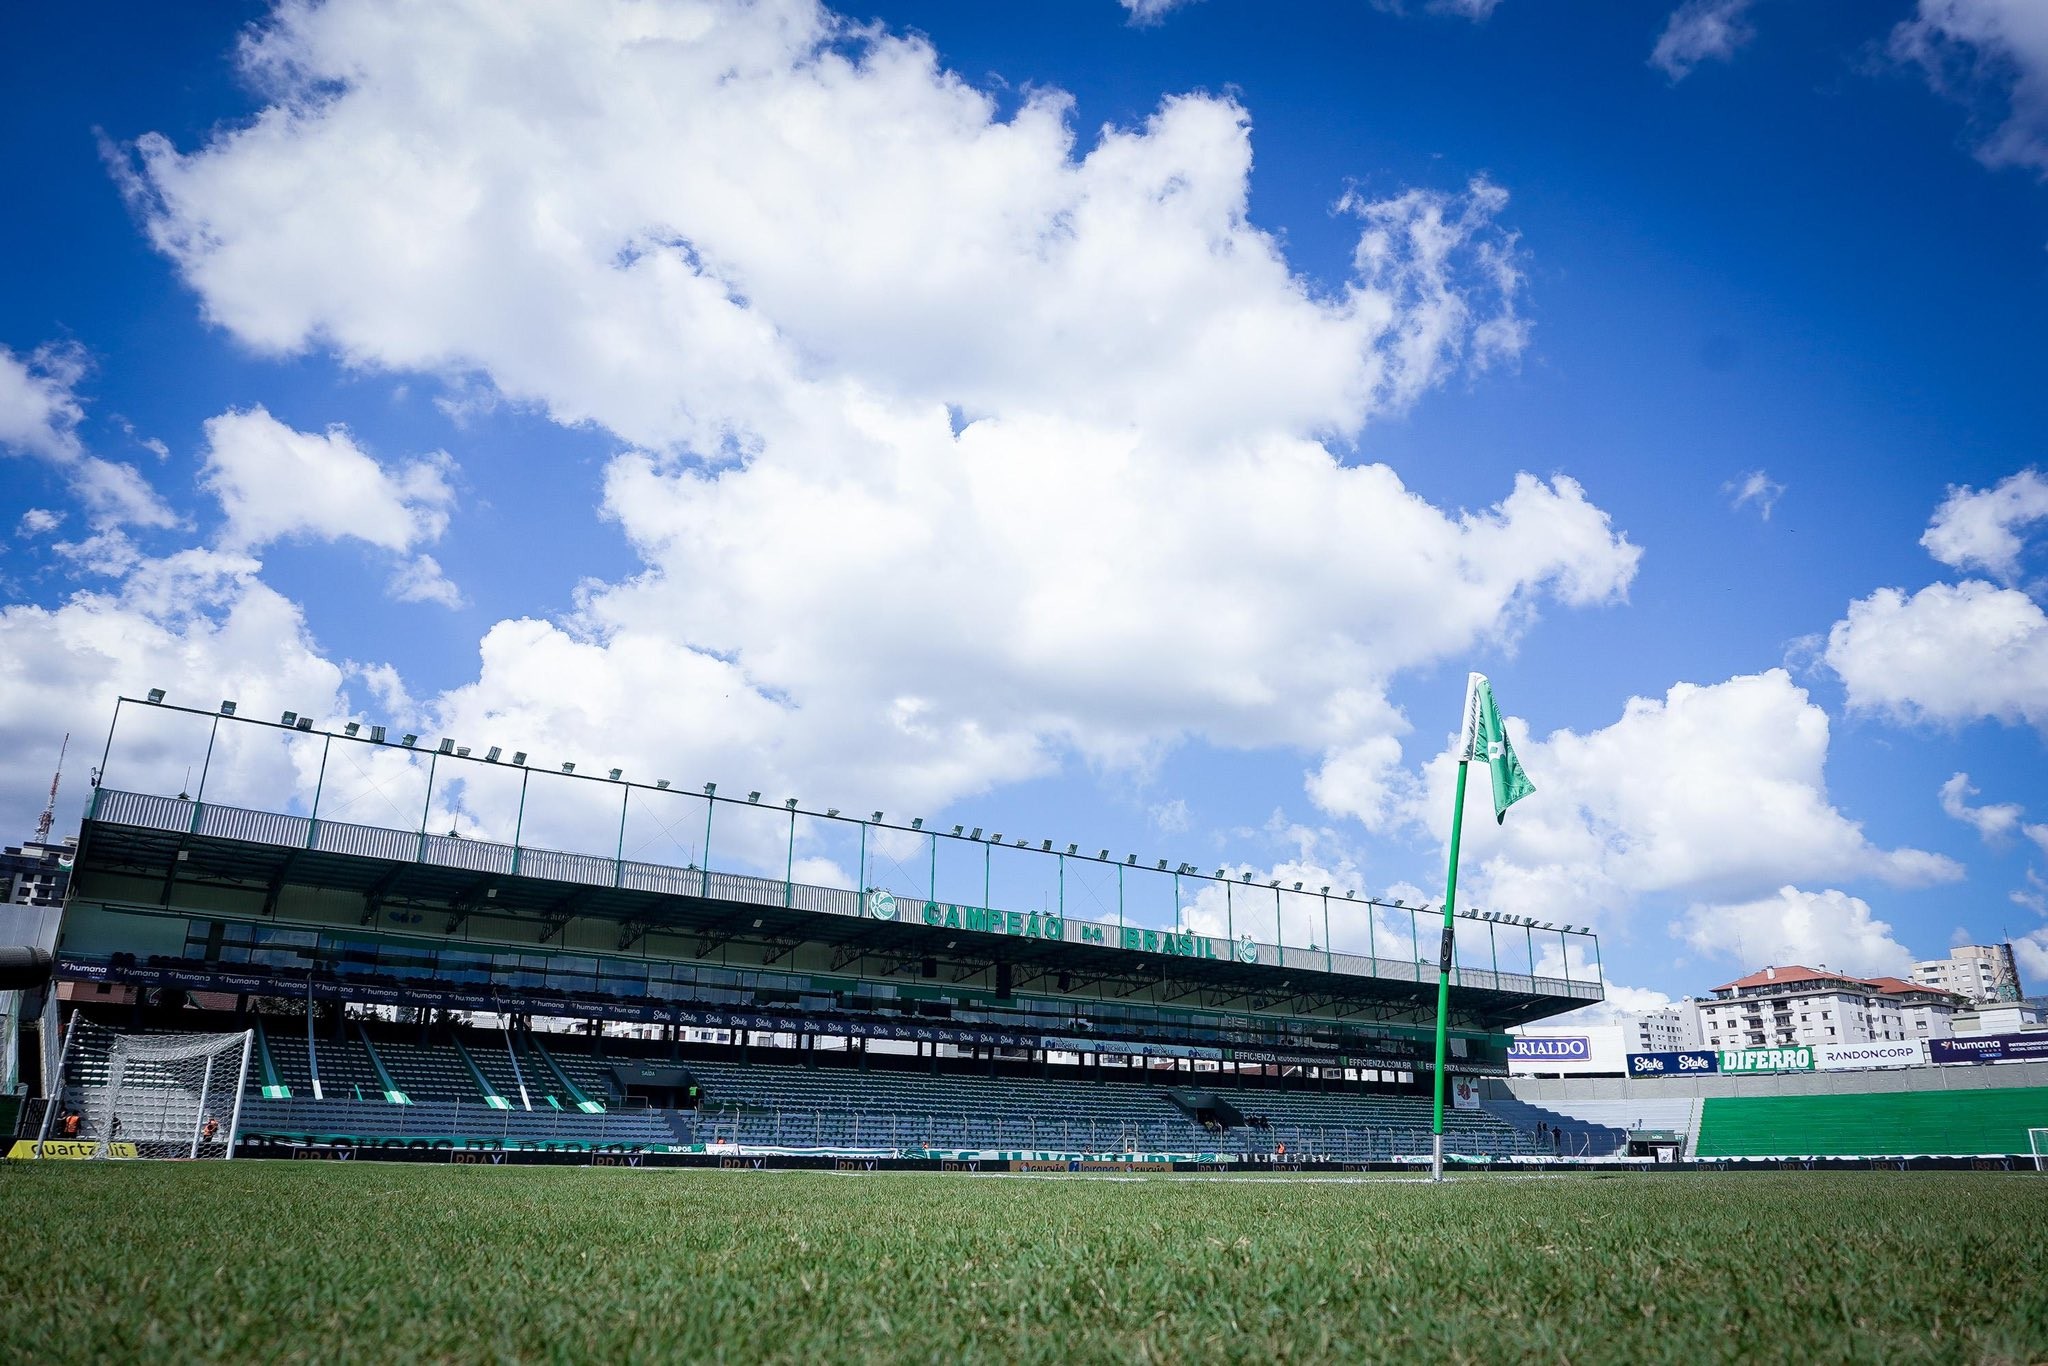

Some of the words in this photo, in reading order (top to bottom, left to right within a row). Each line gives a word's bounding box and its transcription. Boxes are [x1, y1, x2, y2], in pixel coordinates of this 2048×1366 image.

[923, 901, 1061, 939] CAMPEÃO
[1126, 928, 1216, 959] BRASIL
[70, 963, 107, 973] humana
[176, 973, 211, 982] humana
[226, 976, 260, 986] humana
[275, 980, 308, 989] humana
[367, 988, 399, 997] humana
[412, 992, 442, 1000] humana
[537, 1000, 565, 1009] humana
[576, 1003, 603, 1012] humana
[653, 1010, 671, 1021] Stake
[705, 1014, 722, 1025] Stake
[731, 1016, 747, 1027] Stake
[1507, 1040, 1585, 1055] URIALDO
[1952, 1041, 2001, 1050] humana
[1235, 1052, 1276, 1062] EFFICIENZA
[1827, 1047, 1914, 1061] RANDONCORP
[1634, 1057, 1663, 1071] Stake
[1678, 1055, 1709, 1070] Stake
[1723, 1050, 1808, 1070] DIFERRO
[31, 1143, 128, 1158] quartzlit
